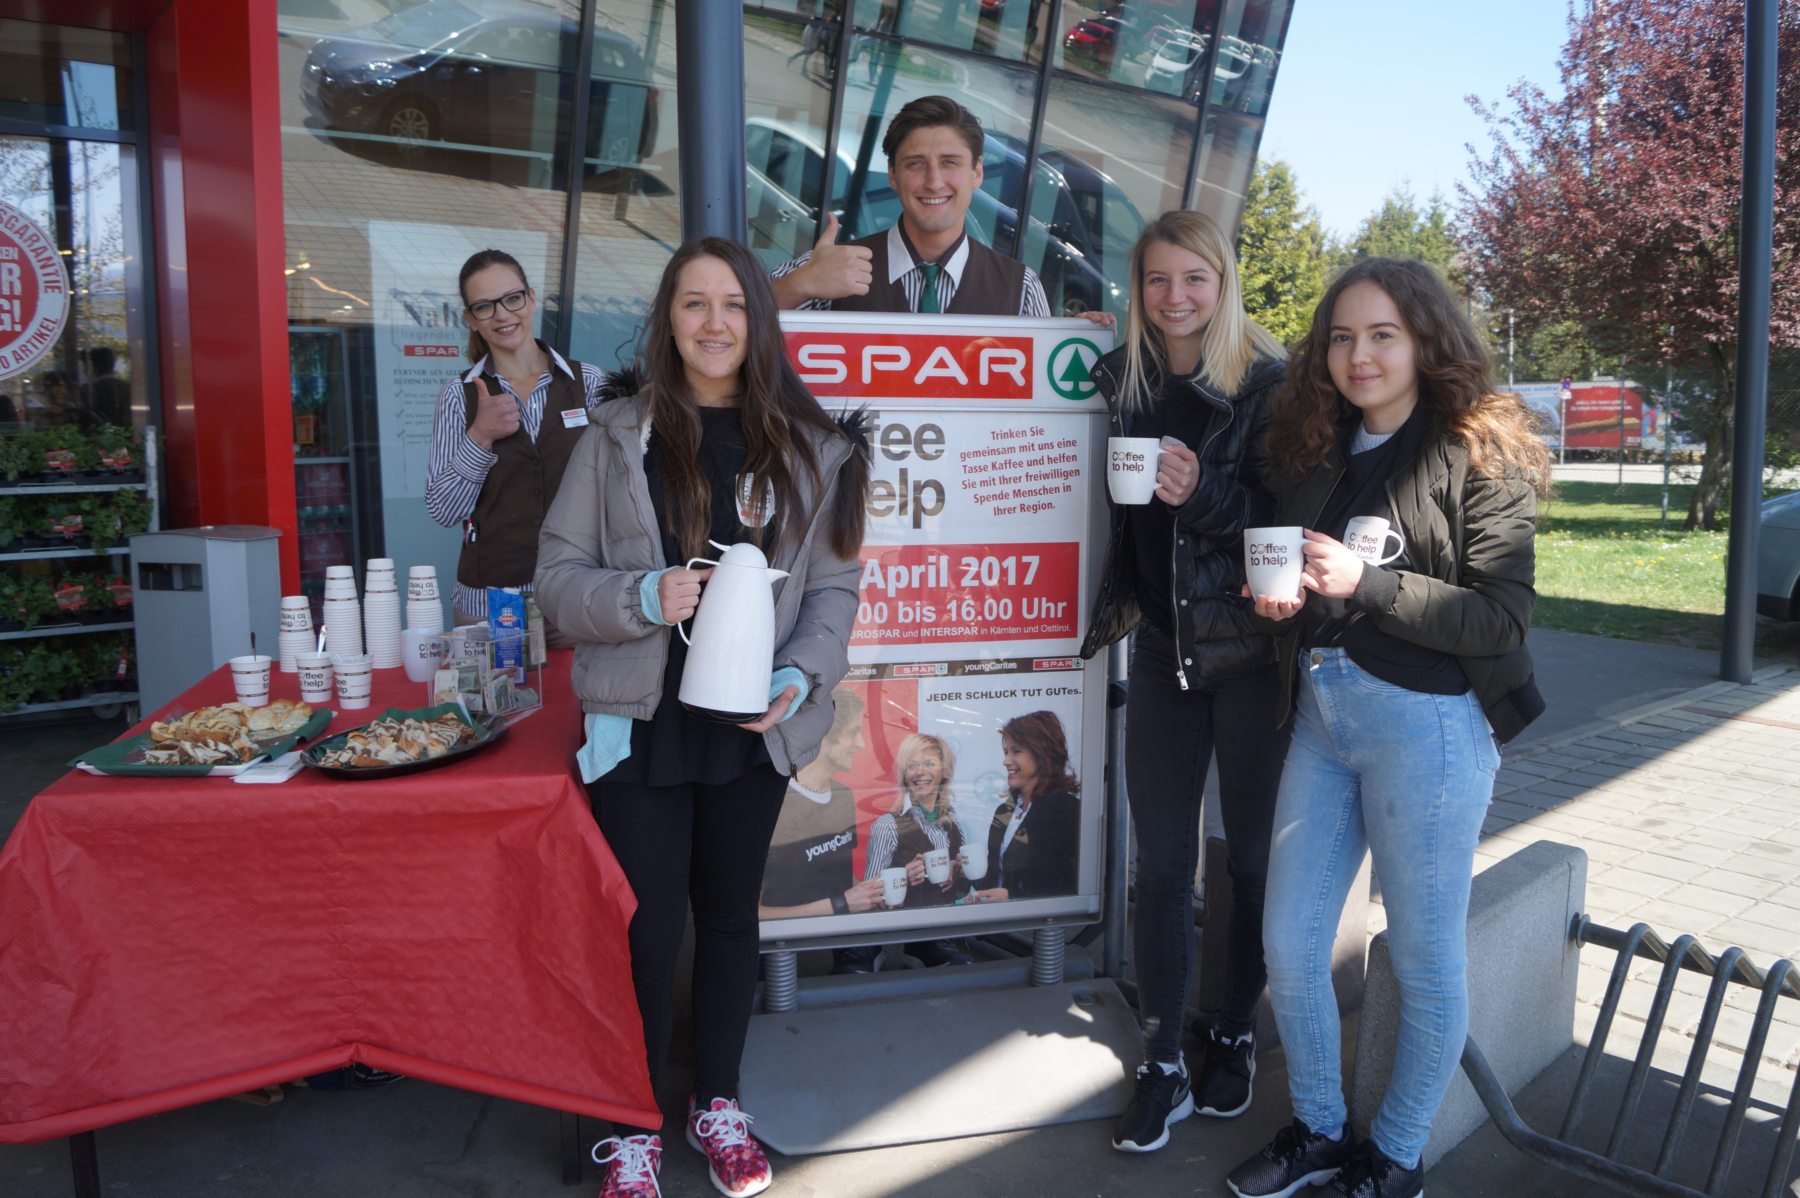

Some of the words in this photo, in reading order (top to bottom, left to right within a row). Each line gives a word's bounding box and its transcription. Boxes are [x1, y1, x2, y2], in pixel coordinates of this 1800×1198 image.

[12, 316, 59, 364] ARTIKEL
[414, 347, 459, 356] SPAR
[797, 344, 1027, 387] SPAR
[991, 429, 1027, 440] Trinken
[1029, 426, 1045, 437] Sie
[960, 445, 1016, 462] gemeinsam
[1019, 442, 1036, 453] mit
[1038, 442, 1054, 451] uns
[1057, 438, 1077, 448] eine
[1112, 451, 1145, 461] Coffee
[962, 464, 989, 474] Tasse
[991, 459, 1024, 471] Kaffee
[1026, 456, 1045, 467] und
[1047, 453, 1078, 465] helfen
[1112, 462, 1121, 471] to
[1122, 462, 1145, 474] help
[962, 479, 977, 490] Sie
[980, 477, 996, 488] mit
[999, 475, 1022, 486] Ihrer
[1025, 468, 1081, 482] freiwilligen
[973, 490, 1010, 505] Spende
[1012, 485, 1060, 499] Menschen
[1063, 483, 1072, 493] in
[993, 505, 1017, 516] Ihrer
[1019, 501, 1056, 514] Region.
[1250, 543, 1287, 555] Coffee
[1347, 541, 1356, 551] to
[1357, 543, 1377, 555] help
[1250, 556, 1260, 567] to
[1262, 555, 1288, 567] help
[859, 555, 949, 598] April
[960, 555, 1040, 588] 2017
[898, 600, 937, 623] bis
[947, 598, 1013, 622] 16.00
[1021, 597, 1067, 619] Uhr
[903, 629, 919, 638] und
[920, 626, 978, 637] INTERSPAR
[980, 626, 988, 635] in
[1024, 624, 1039, 633] und
[903, 666, 936, 675] SPAR
[964, 661, 1018, 673] youngCaritas
[1041, 660, 1073, 669] SPAR
[926, 692, 963, 702] JEDER
[965, 689, 1017, 700] SCHLUCK
[1021, 688, 1042, 698] TUT
[1046, 687, 1082, 697] GUTes.
